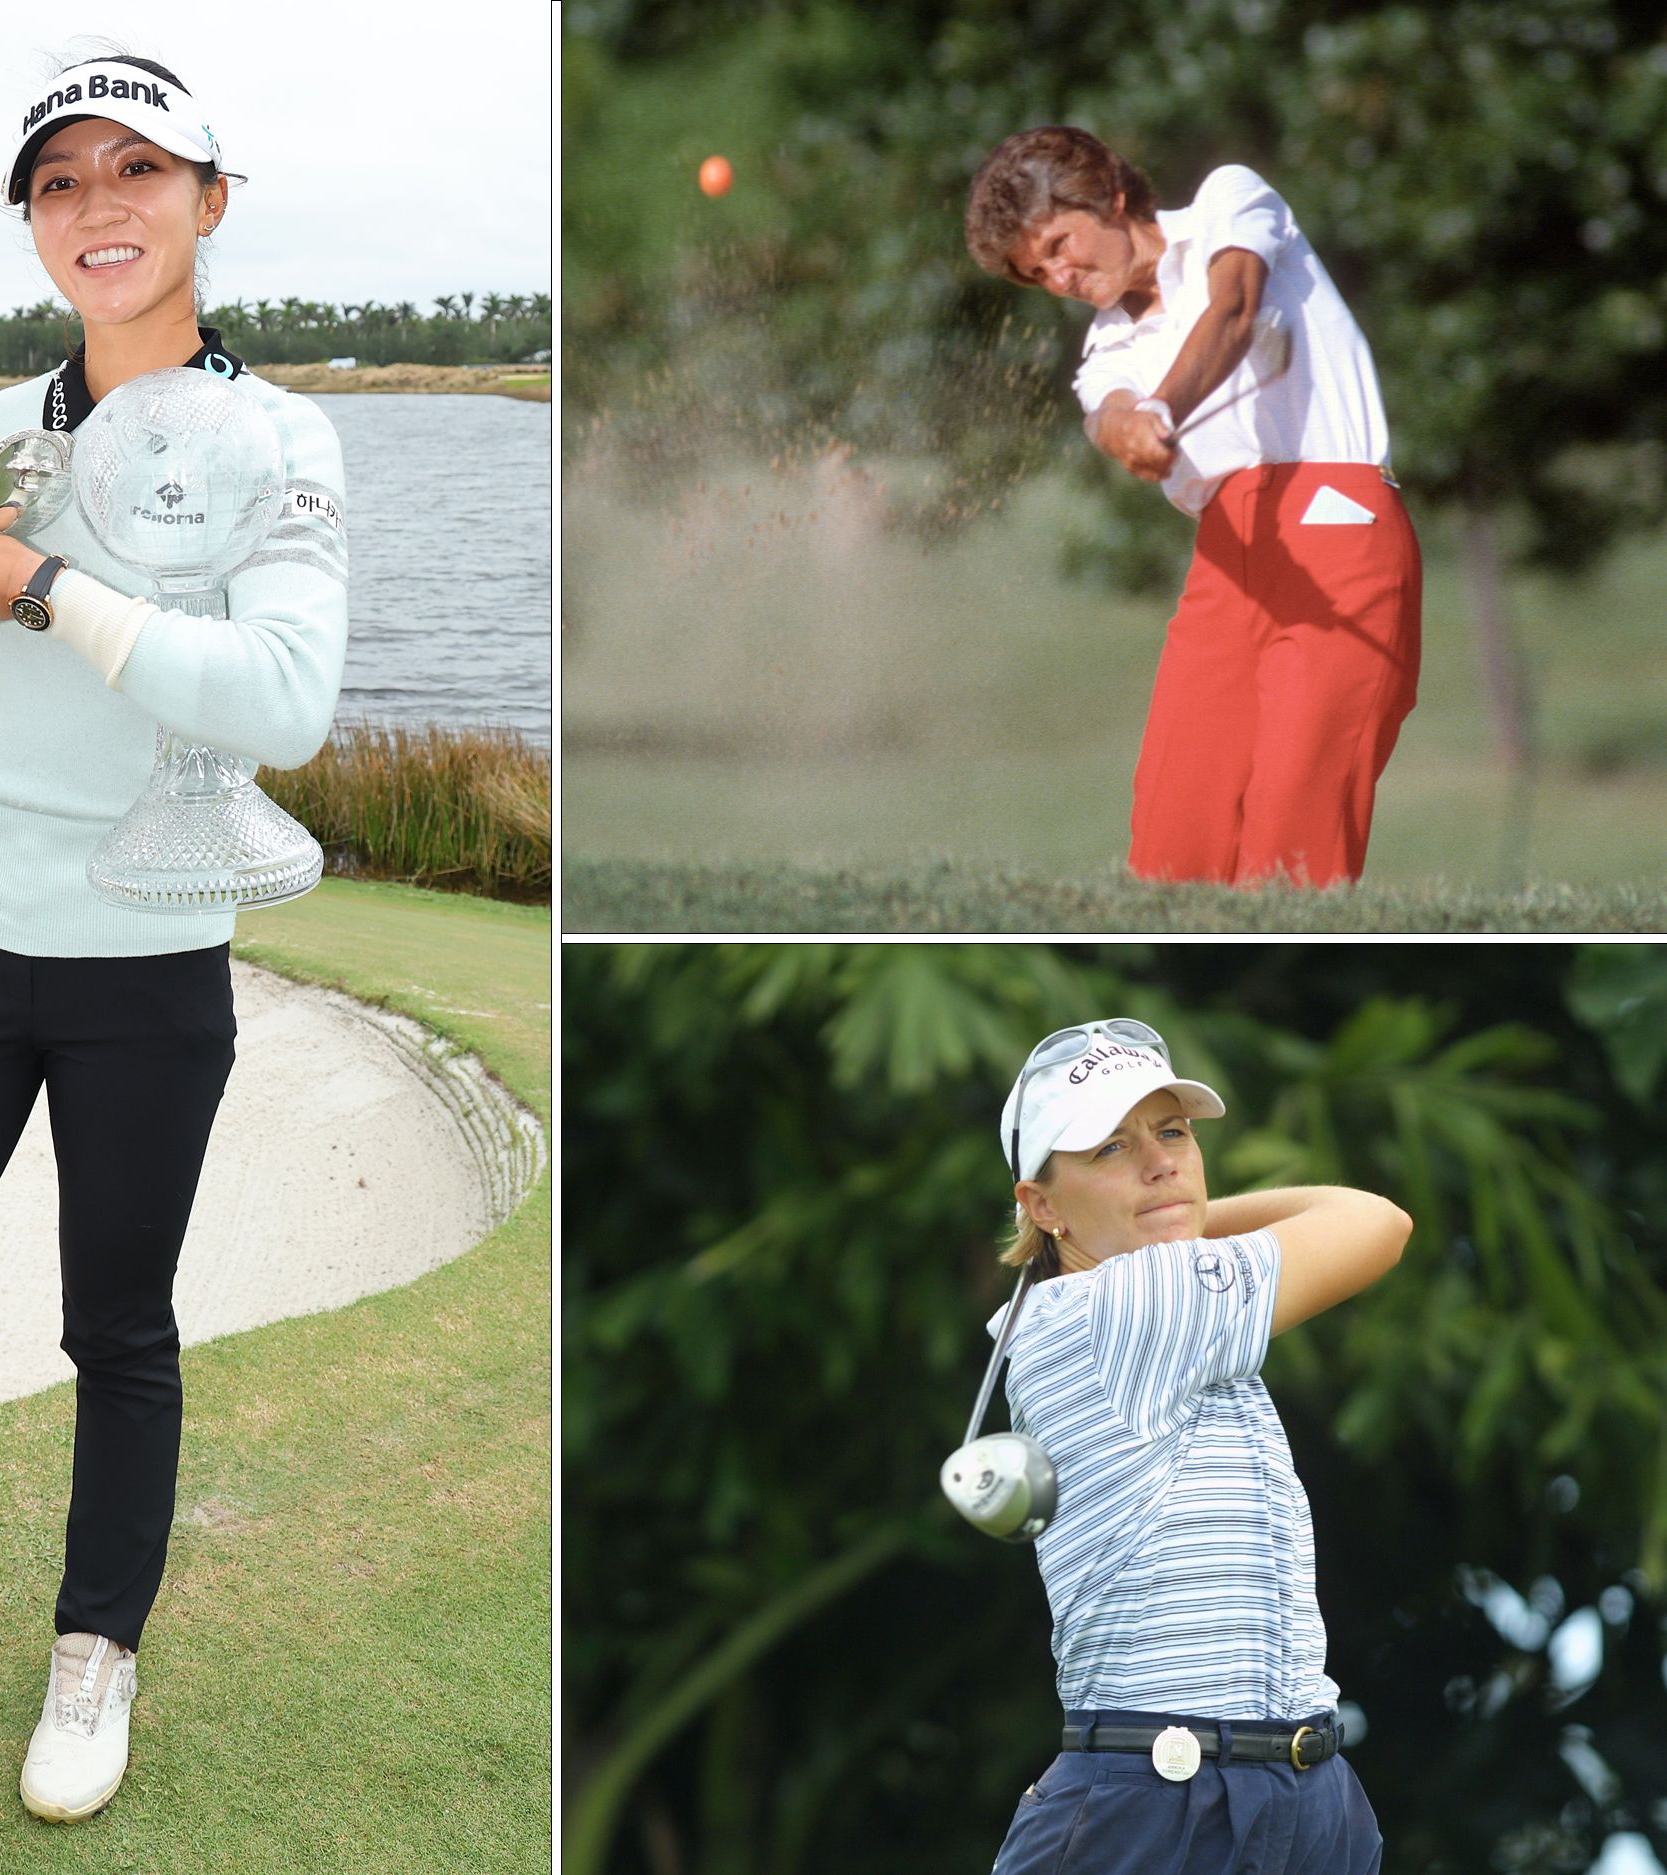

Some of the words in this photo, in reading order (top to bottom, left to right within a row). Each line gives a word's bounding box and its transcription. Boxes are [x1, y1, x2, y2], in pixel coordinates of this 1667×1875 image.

[22, 83, 83, 136] Hana
[88, 74, 170, 112] Bank
[1068, 1045, 1162, 1085] Callaway
[1101, 1061, 1142, 1076] GOLF
